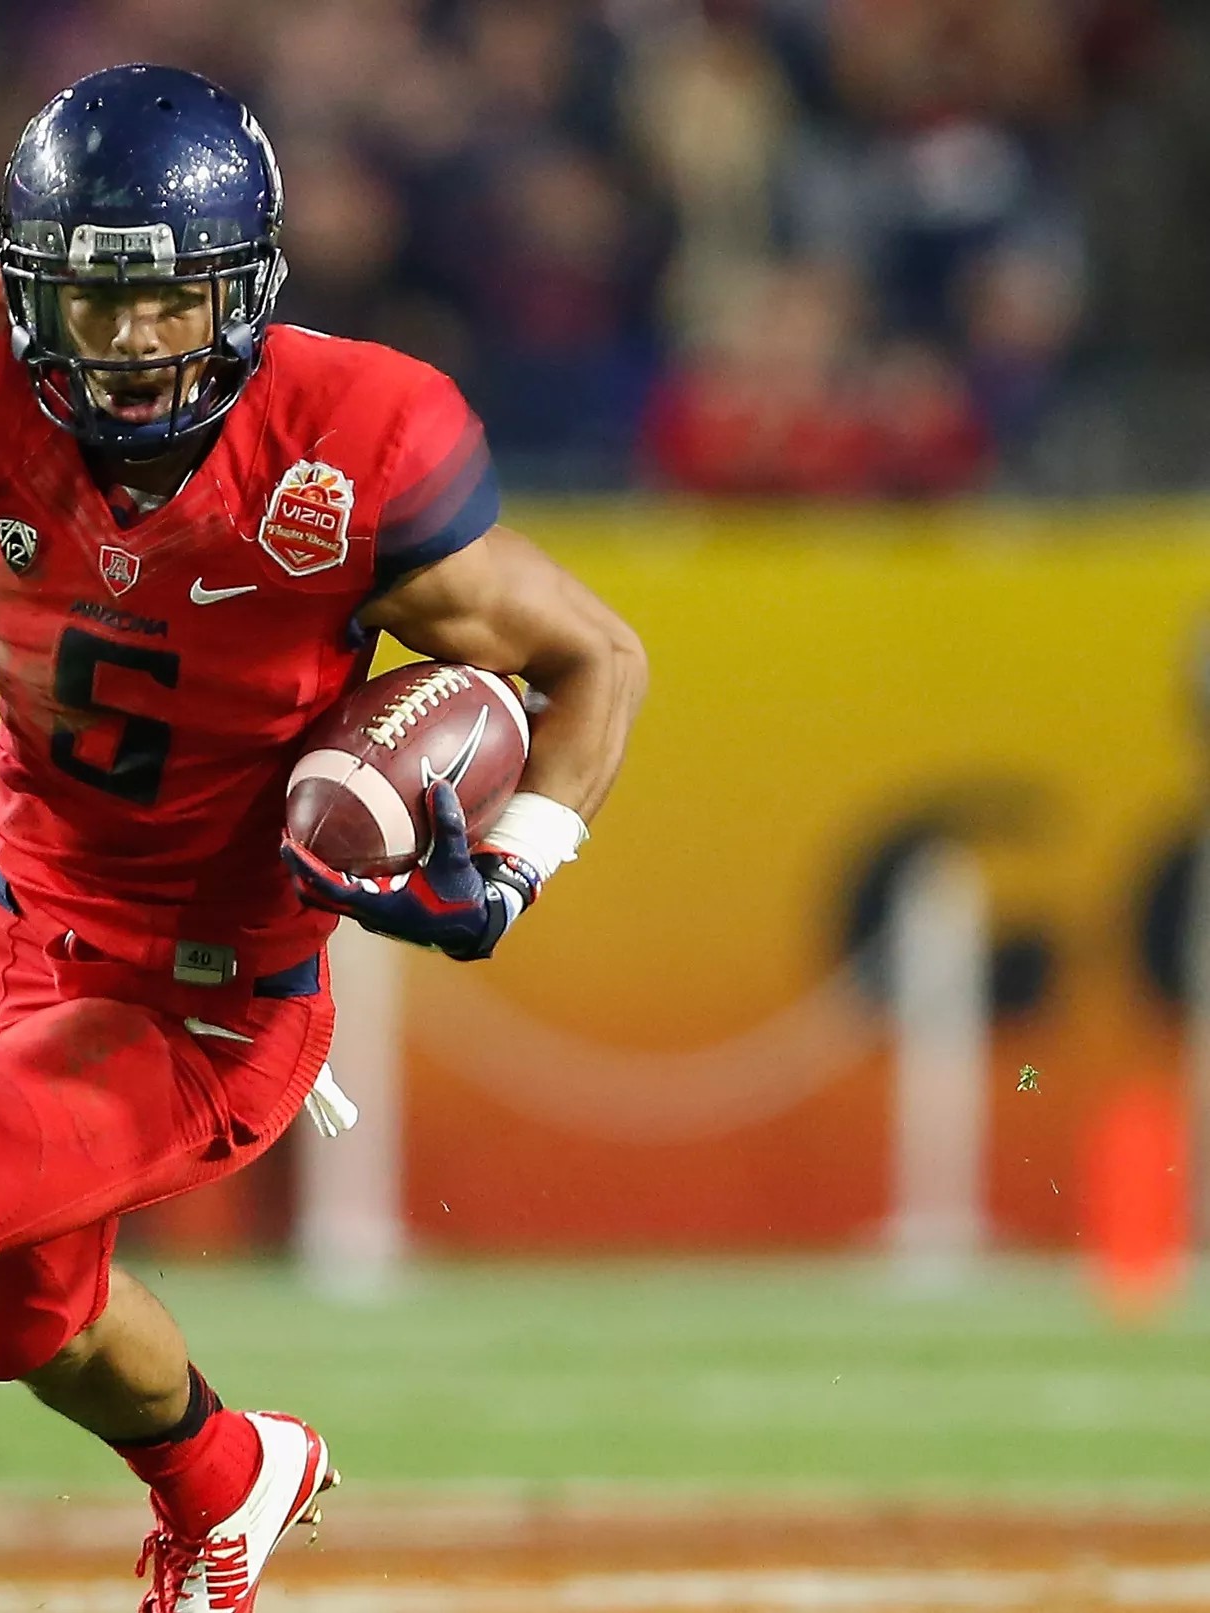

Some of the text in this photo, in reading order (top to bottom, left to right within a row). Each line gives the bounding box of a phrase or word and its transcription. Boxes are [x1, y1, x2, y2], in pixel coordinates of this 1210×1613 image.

[282, 502, 336, 530] VIZIO
[6, 541, 26, 566] 12
[105, 552, 131, 584] A
[204, 1533, 250, 1611] NIKE
